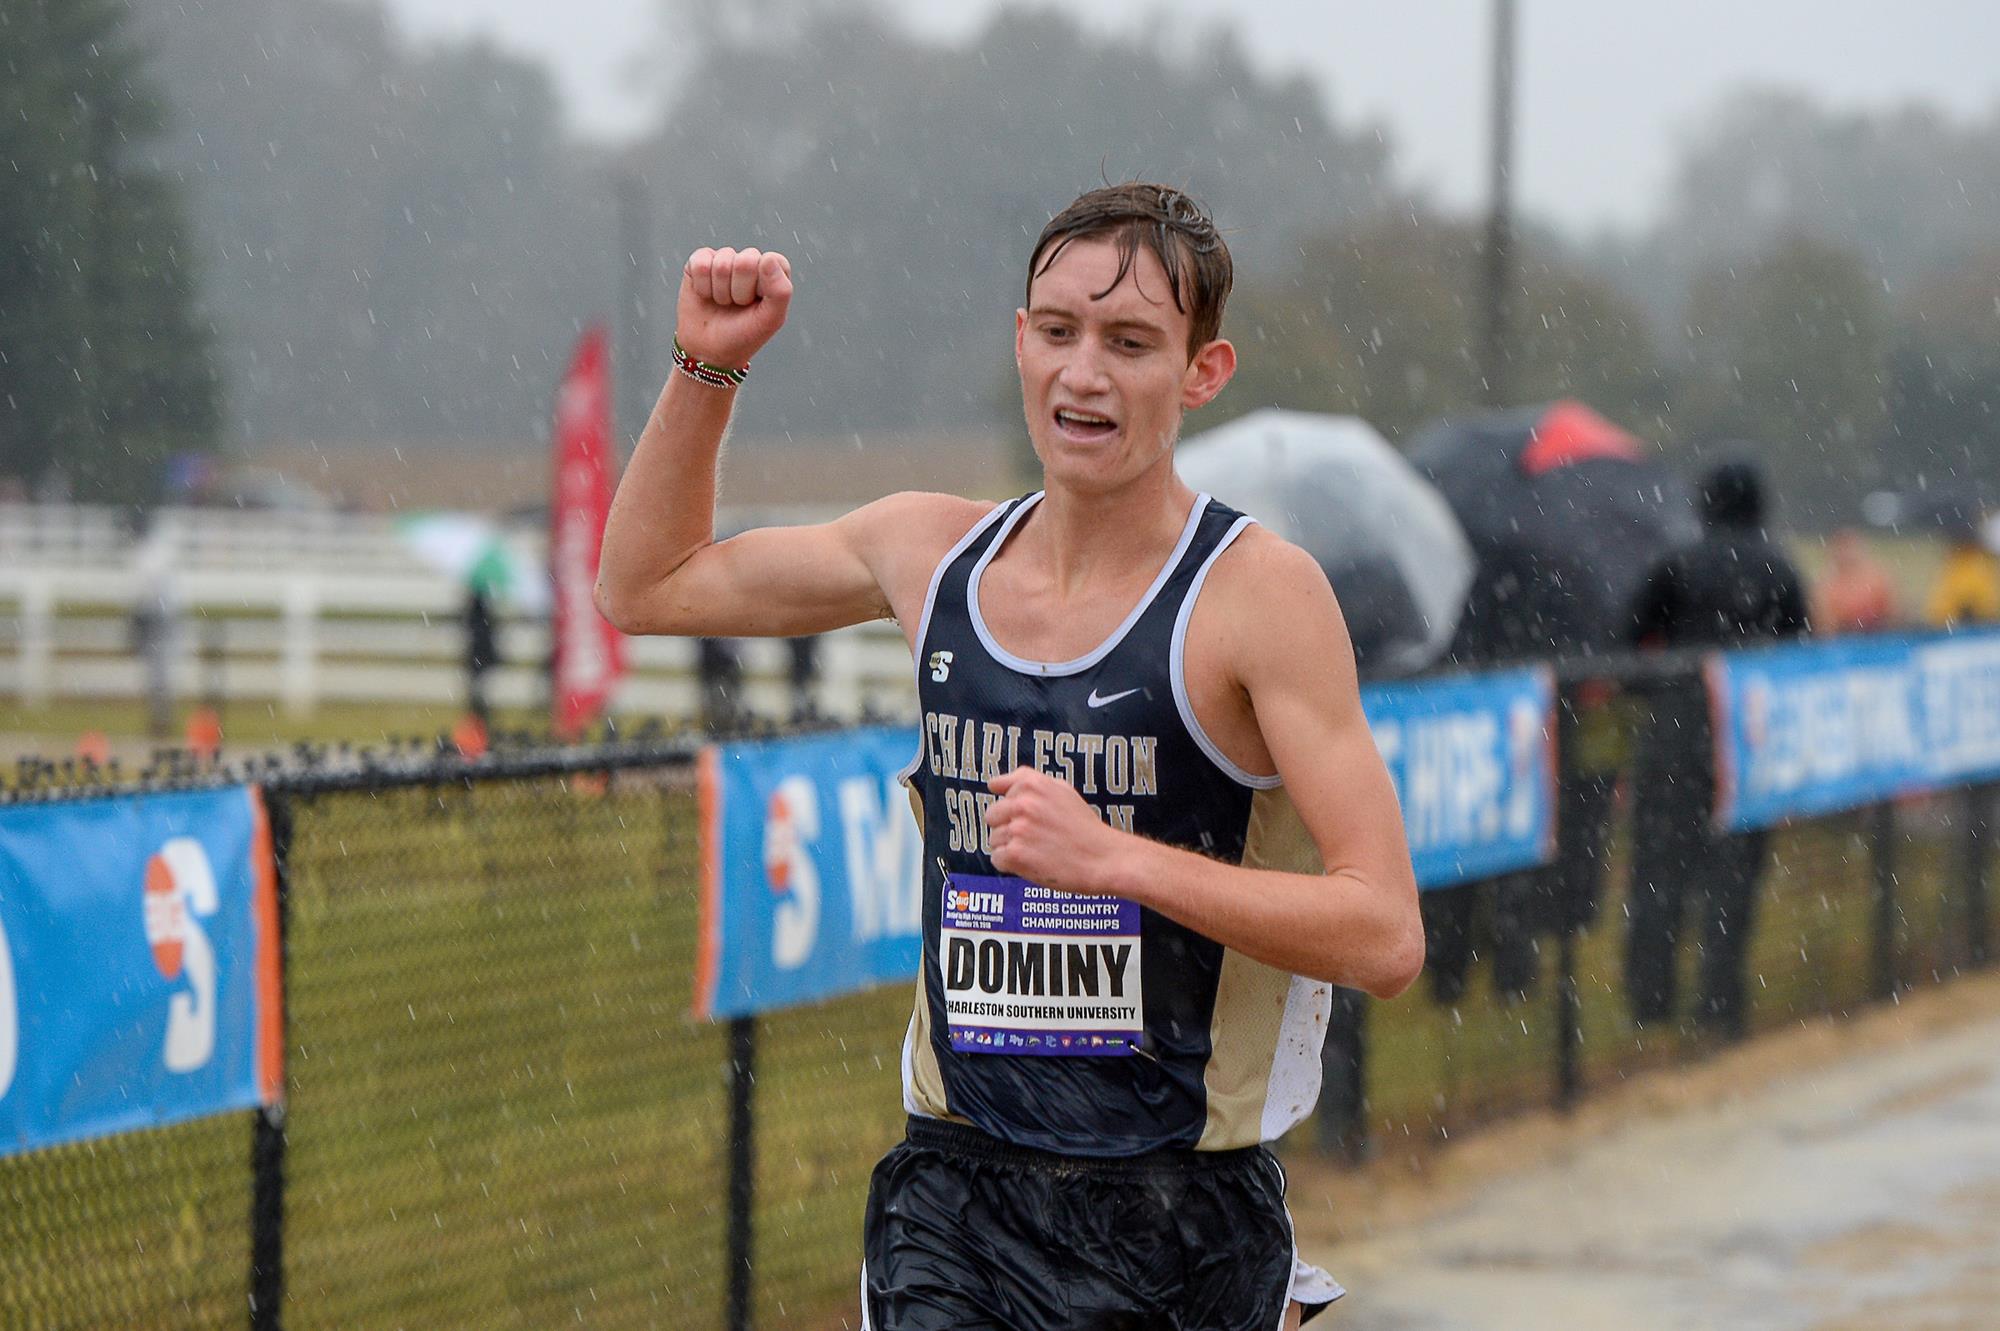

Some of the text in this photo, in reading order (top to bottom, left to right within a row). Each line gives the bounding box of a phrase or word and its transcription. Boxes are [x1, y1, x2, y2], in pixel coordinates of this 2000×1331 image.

[926, 712, 1158, 795] CHARLESTON
[1024, 887, 1051, 899] 2018
[1022, 902, 1119, 915] CROSS COUNTRY
[1022, 917, 1120, 930] CHAMPIONSHIPS
[947, 937, 1132, 997] DOMINY
[1006, 1005, 1064, 1019] SOUTHERN
[1067, 1006, 1136, 1020] UNIVERSITY
